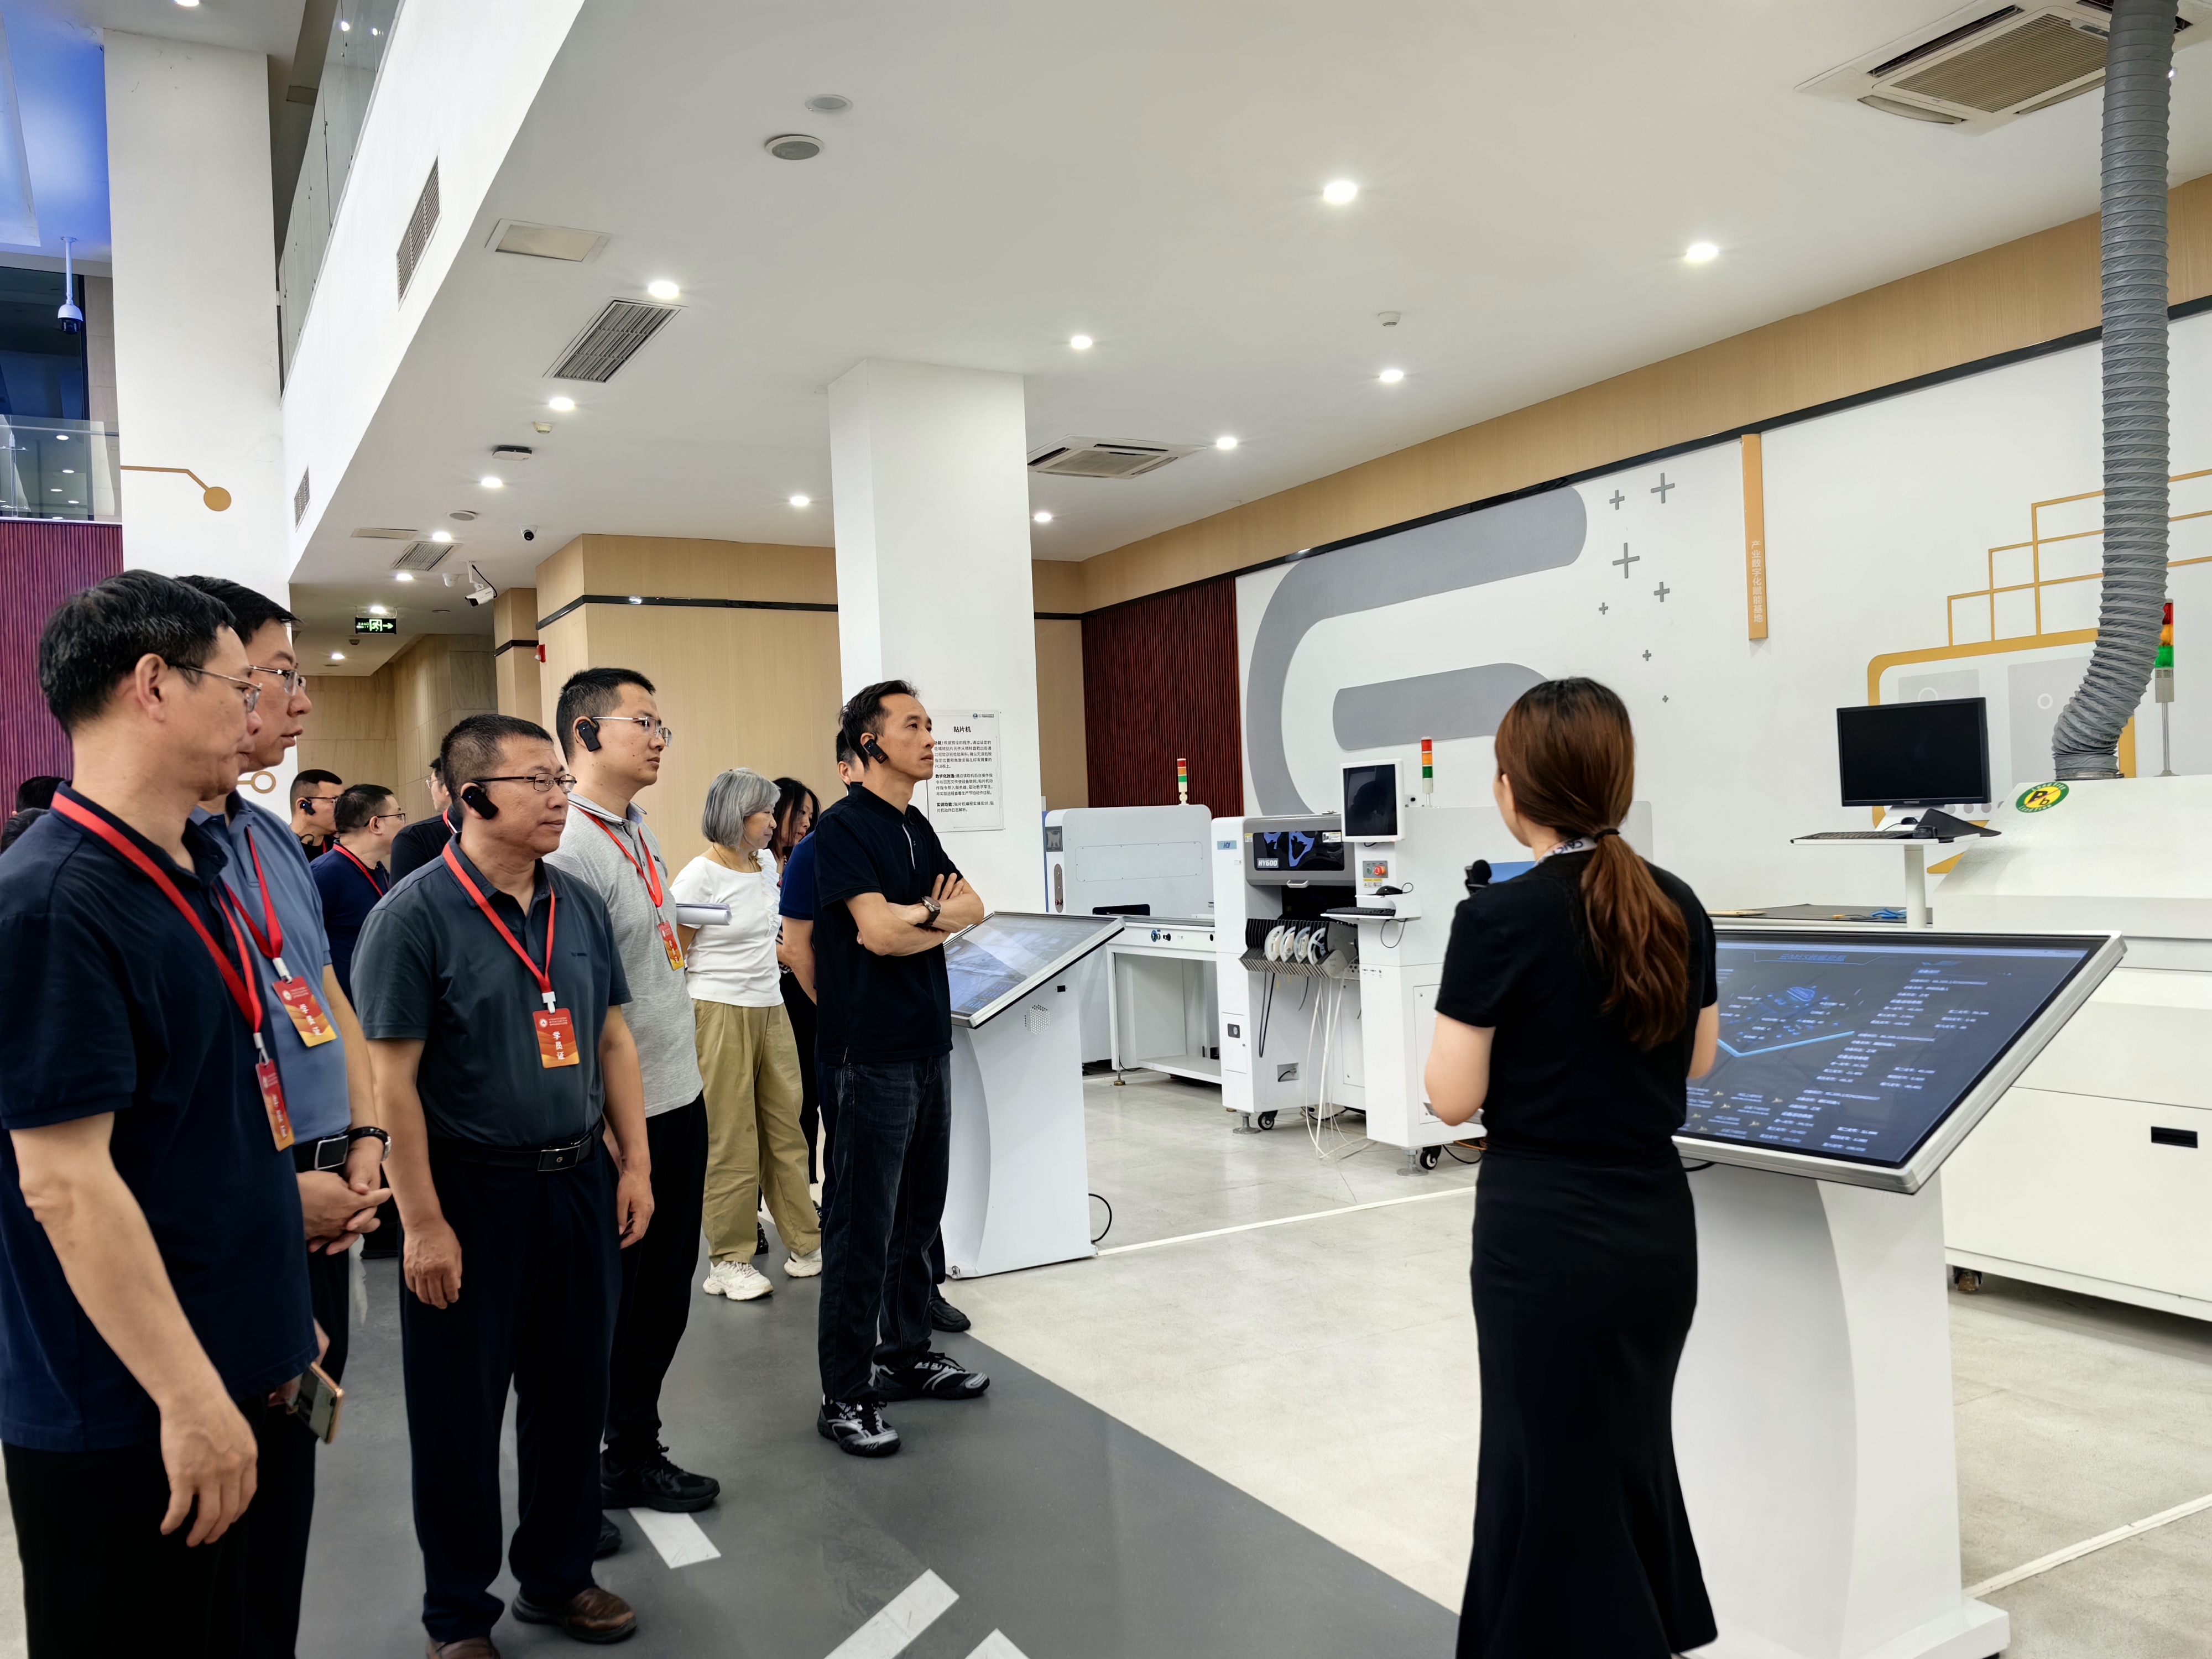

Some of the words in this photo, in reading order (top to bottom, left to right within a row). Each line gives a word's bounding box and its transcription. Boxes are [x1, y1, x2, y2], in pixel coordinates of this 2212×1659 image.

[1751, 540, 1763, 623] 产业数字化赋能基地
[2027, 791, 2050, 806] Pb
[552, 1031, 565, 1060] 学员证
